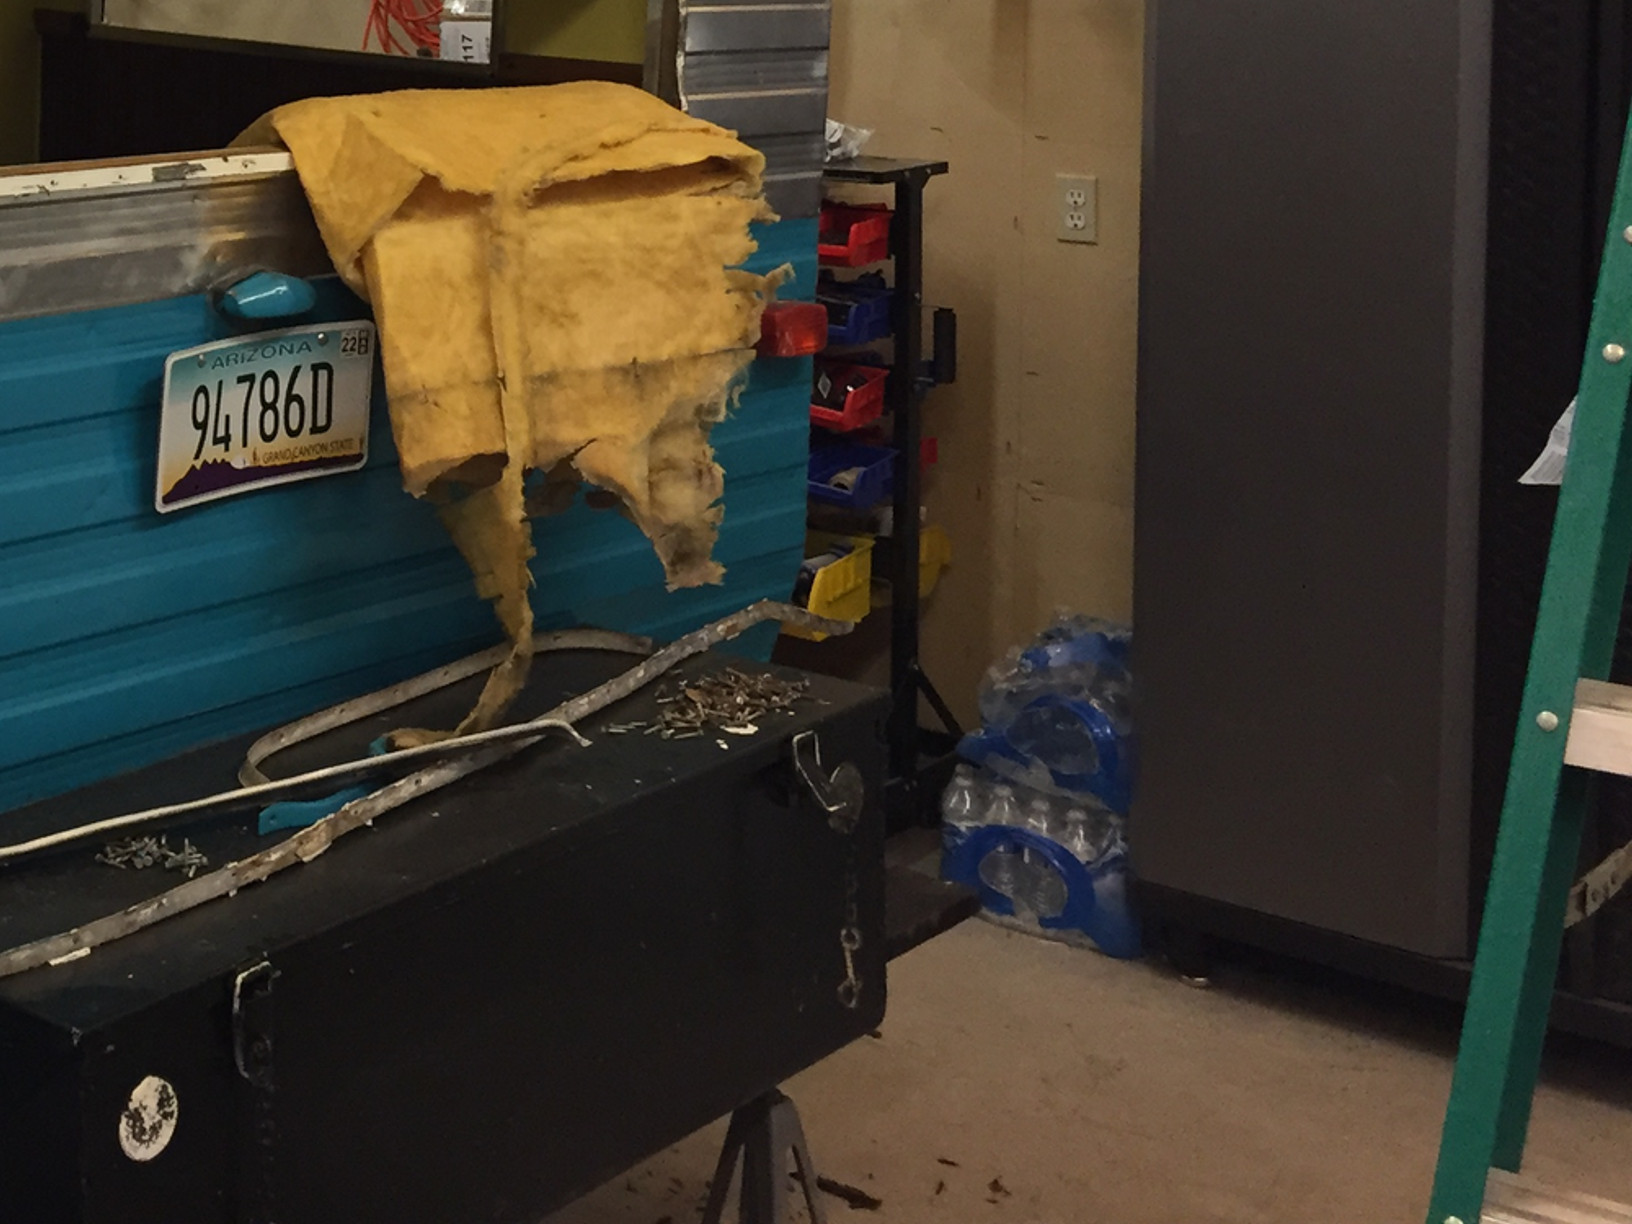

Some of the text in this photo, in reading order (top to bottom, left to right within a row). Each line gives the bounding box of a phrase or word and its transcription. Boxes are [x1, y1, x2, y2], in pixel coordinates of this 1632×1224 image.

[211, 340, 312, 370] ARIZONA
[341, 336, 357, 353] 22
[191, 361, 335, 460] 94786D
